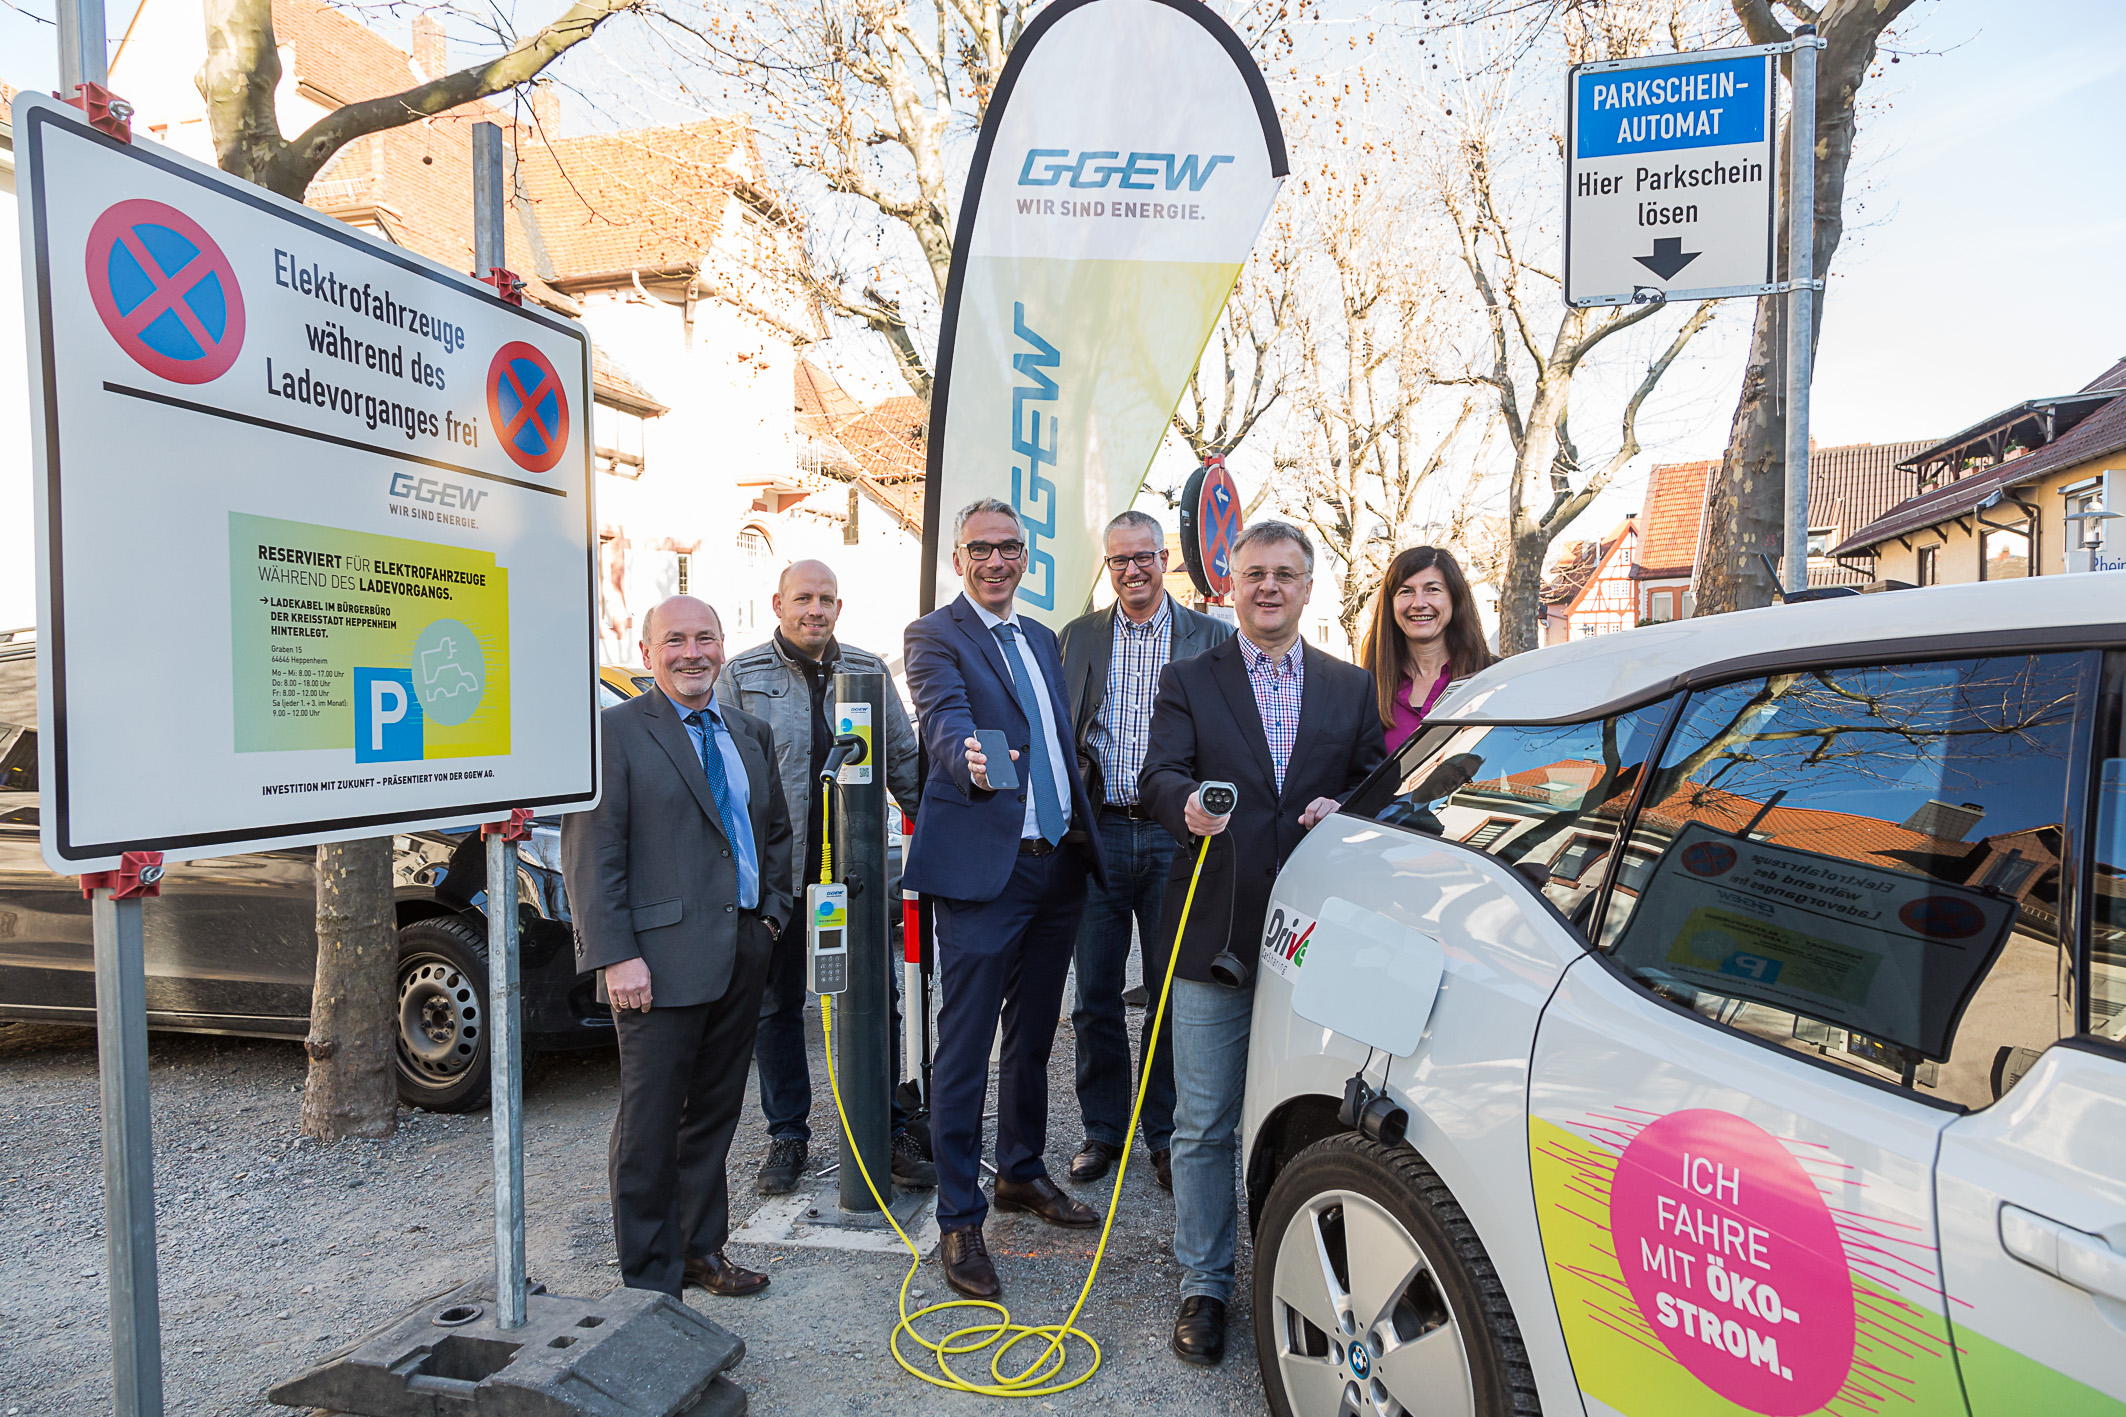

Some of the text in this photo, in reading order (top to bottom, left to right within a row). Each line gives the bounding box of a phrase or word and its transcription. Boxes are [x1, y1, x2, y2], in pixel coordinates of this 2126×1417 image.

[1593, 71, 1749, 111] PARKSCHEIN-
[1616, 108, 1724, 144] AUTOMAT
[1017, 148, 1235, 192] GGEW
[1577, 158, 1763, 197] Hier Parkschein
[1016, 198, 1206, 221] WIR SIND ENERGIE.
[1638, 201, 1698, 227] lösen
[274, 247, 465, 354] Elektrofahrzeuge
[305, 320, 446, 391] während des
[266, 356, 478, 448] Ladevorganges frei
[1012, 300, 1060, 611] GGEW
[389, 472, 488, 512] GGEW
[389, 503, 479, 529] WIR SIND ENERGIE.
[258, 544, 486, 586] RESERVIERT FÜR ELEKTROFAHRZEUGE
[258, 564, 453, 600] WÄHREND DES LADEVORGANGS.
[270, 597, 391, 616] LADEKABEL IM BÜRGERBÜRO
[270, 611, 397, 629] DER KREISSTADT HEPPENHEIM
[271, 625, 329, 638] HINTERLEGT.
[271, 645, 302, 654] Graben 15
[271, 655, 328, 665] 64646 Heppenheim
[272, 679, 283, 687] Do:
[272, 699, 280, 707] Sa
[272, 709, 286, 717] 9.00
[292, 709, 308, 717] 12.00
[371, 680, 408, 750] P
[262, 782, 319, 796] INVESTITION
[320, 781, 336, 791] MIT
[337, 778, 375, 790] ZUKUNFT
[382, 774, 433, 786] PRÄSENTIERT
[433, 773, 448, 782] VON
[449, 771, 463, 781] DER
[463, 770, 483, 780] GGEW
[484, 769, 495, 778] AG.
[1682, 1152, 1740, 1206] ICH
[1657, 1194, 1771, 1270] FAHRE
[1640, 1236, 1800, 1324] MIT ÖKO-
[1656, 1291, 1793, 1382] STROM.
